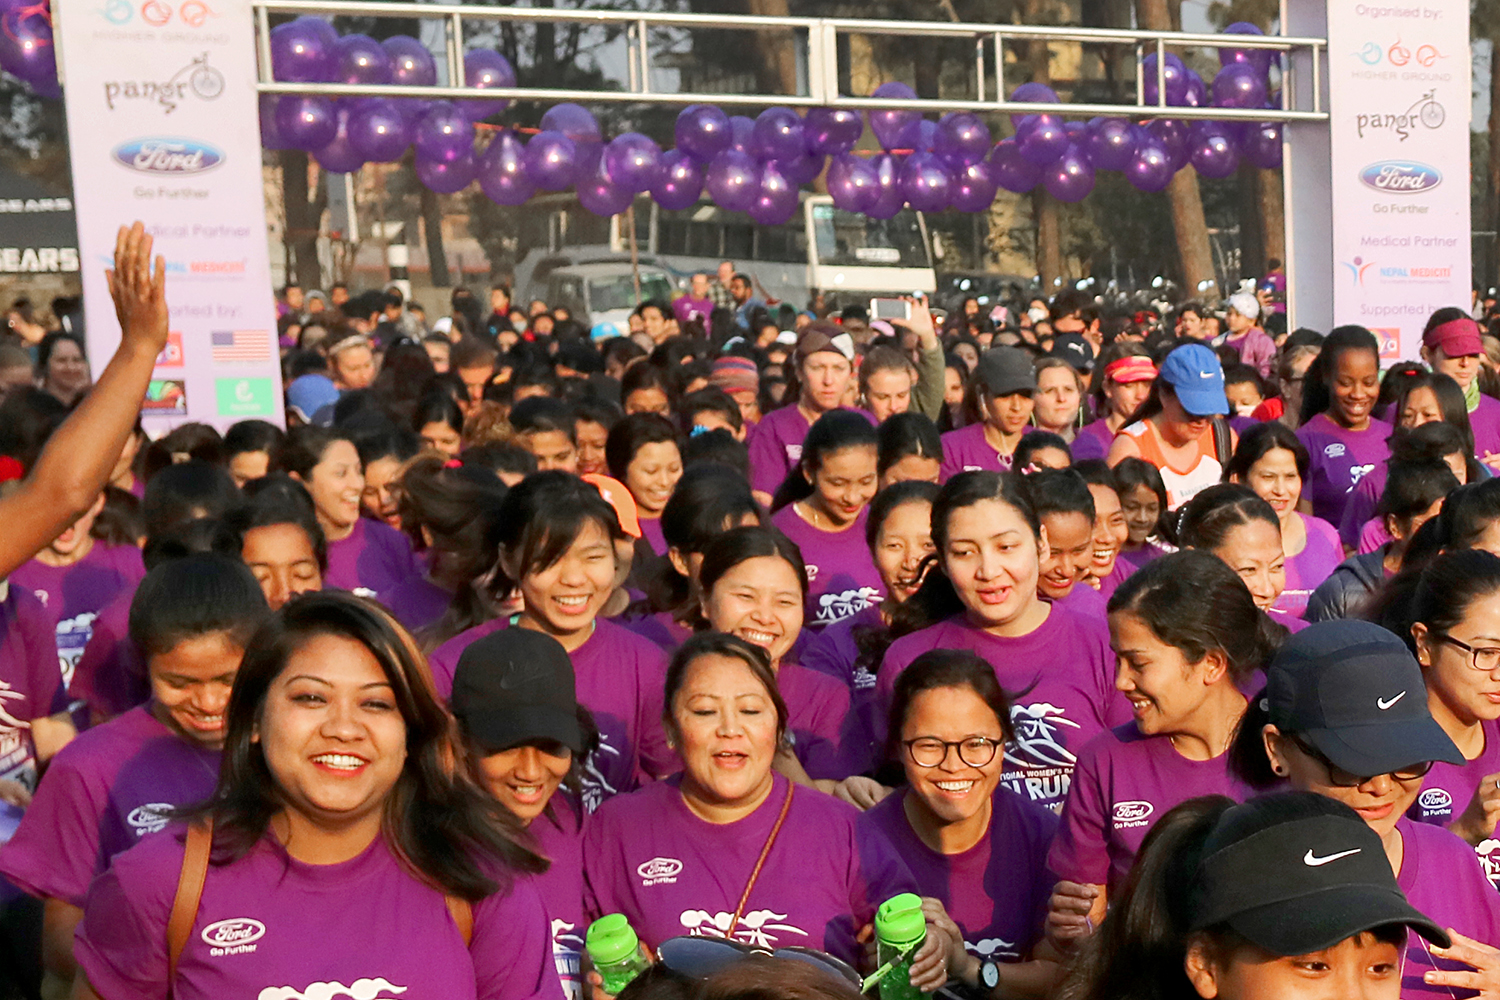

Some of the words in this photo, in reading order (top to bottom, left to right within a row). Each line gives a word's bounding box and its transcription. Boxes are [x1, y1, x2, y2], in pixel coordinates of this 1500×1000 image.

[1355, 4, 1419, 19] Organised
[1423, 7, 1443, 20] by:
[1372, 203, 1389, 214] Go
[1390, 202, 1429, 214] Further
[1360, 235, 1411, 248] Medical
[1414, 235, 1458, 248] Partner
[0, 247, 80, 272] EARS
[1380, 267, 1408, 278] NEPAL
[1410, 267, 1451, 278] MEDICITI
[1360, 303, 1424, 317] Supported
[224, 944, 257, 956] Further
